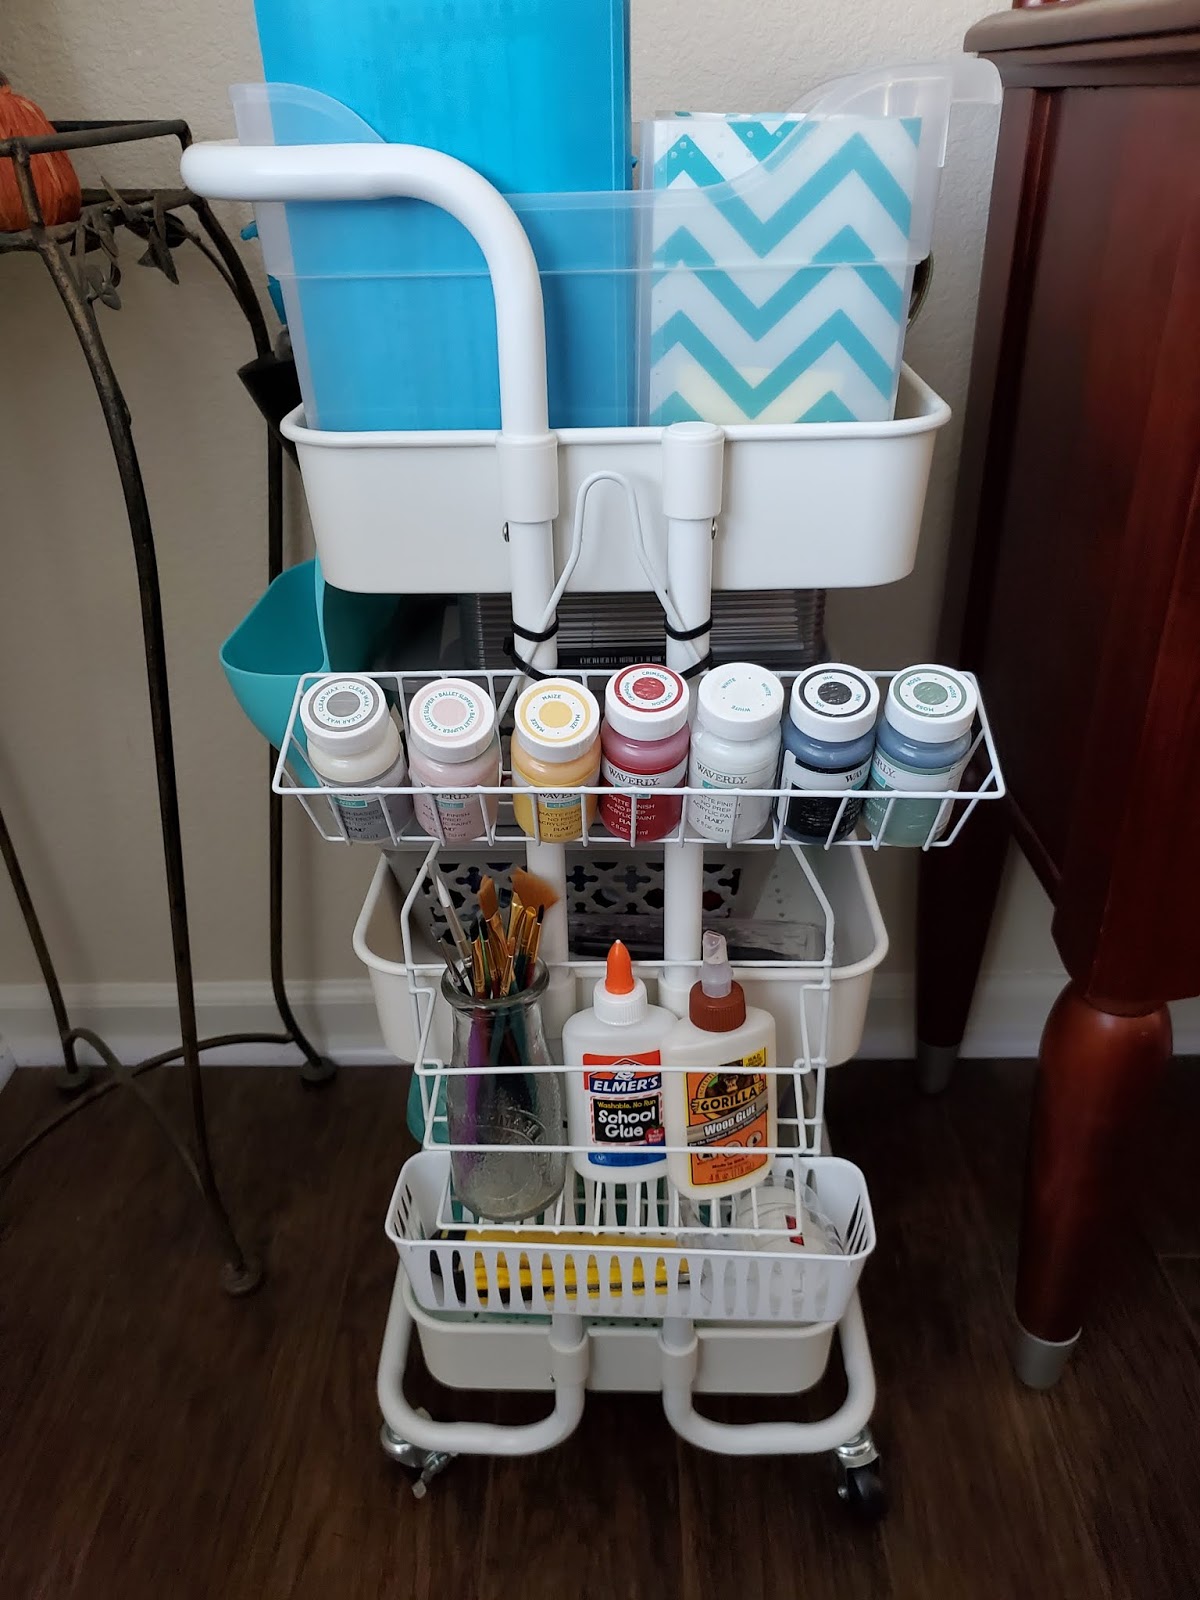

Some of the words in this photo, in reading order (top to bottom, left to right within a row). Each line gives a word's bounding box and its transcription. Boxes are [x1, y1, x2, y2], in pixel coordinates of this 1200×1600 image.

[641, 671, 668, 681] CRIMSON
[906, 677, 922, 686] MOSS
[721, 677, 737, 689] WHITE
[325, 686, 339, 696] WAX
[348, 684, 366, 695] CLEAR
[947, 685, 957, 699] MOSS
[458, 693, 475, 709] SLIPPER
[731, 704, 751, 712] WHITE
[530, 718, 545, 733] MAIZE
[569, 714, 581, 730] MAIZE
[614, 803, 626, 811] NO
[626, 807, 646, 815] PEP
[711, 805, 731, 813] PREP
[593, 1076, 659, 1093] ELMER'S
[643, 1099, 656, 1107] Run
[700, 1086, 758, 1111] GORILLA
[597, 1105, 656, 1124] School
[604, 1124, 644, 1138] Glue
